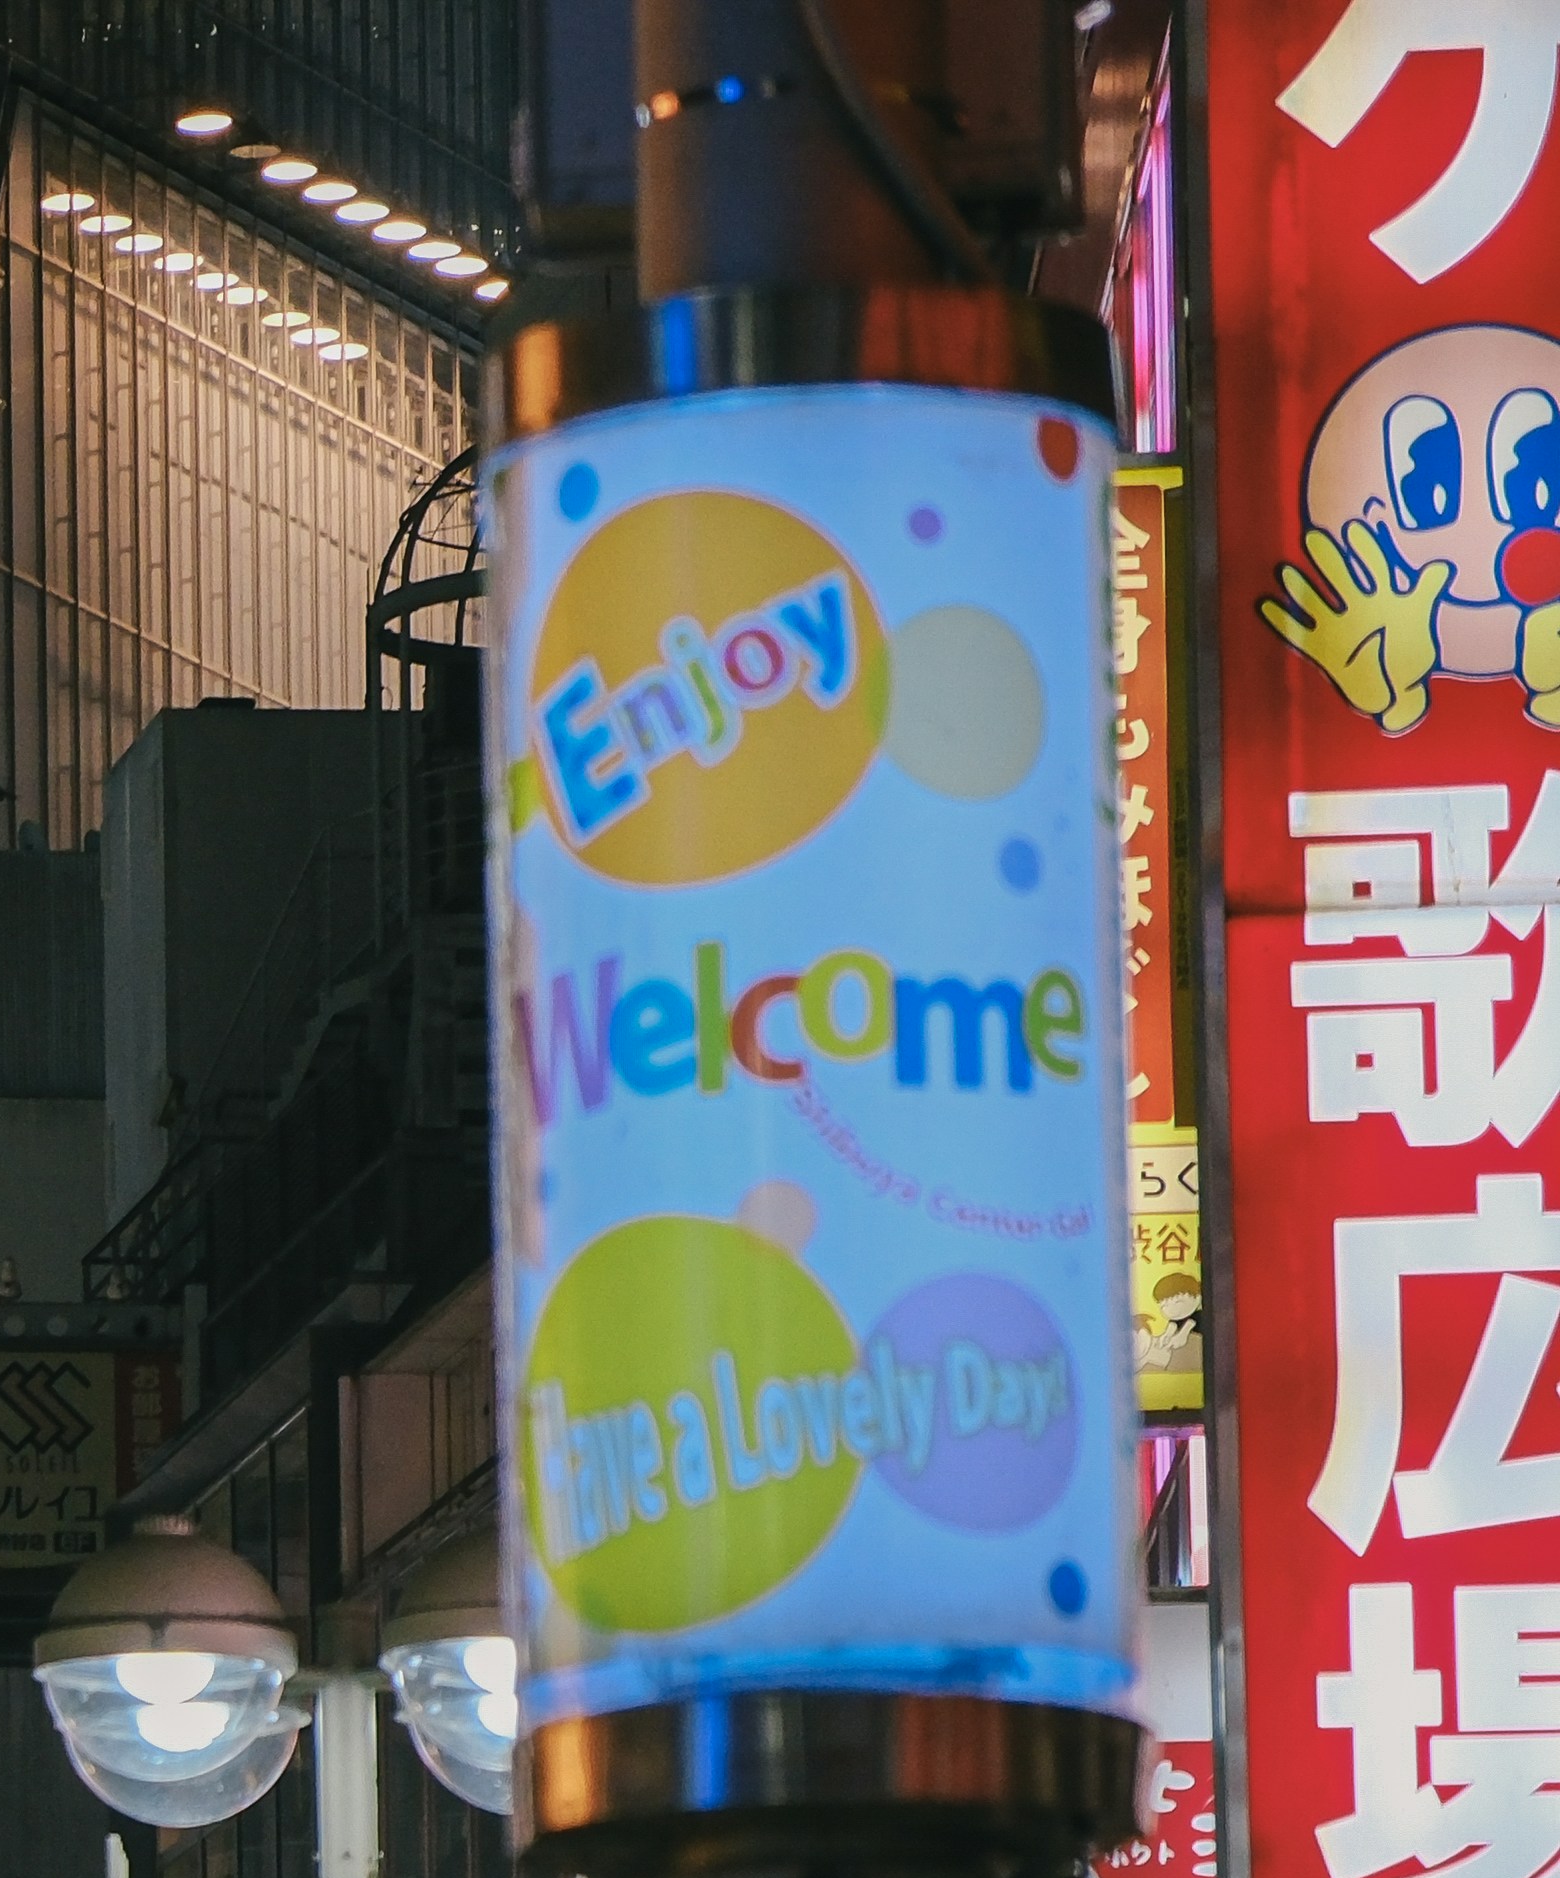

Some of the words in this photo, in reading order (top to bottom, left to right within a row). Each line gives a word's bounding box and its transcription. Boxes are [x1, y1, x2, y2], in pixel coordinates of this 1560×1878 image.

[539, 576, 853, 837] Enjoy
[514, 941, 1083, 1127] Welcome
[716, 1350, 938, 1492] Lovely
